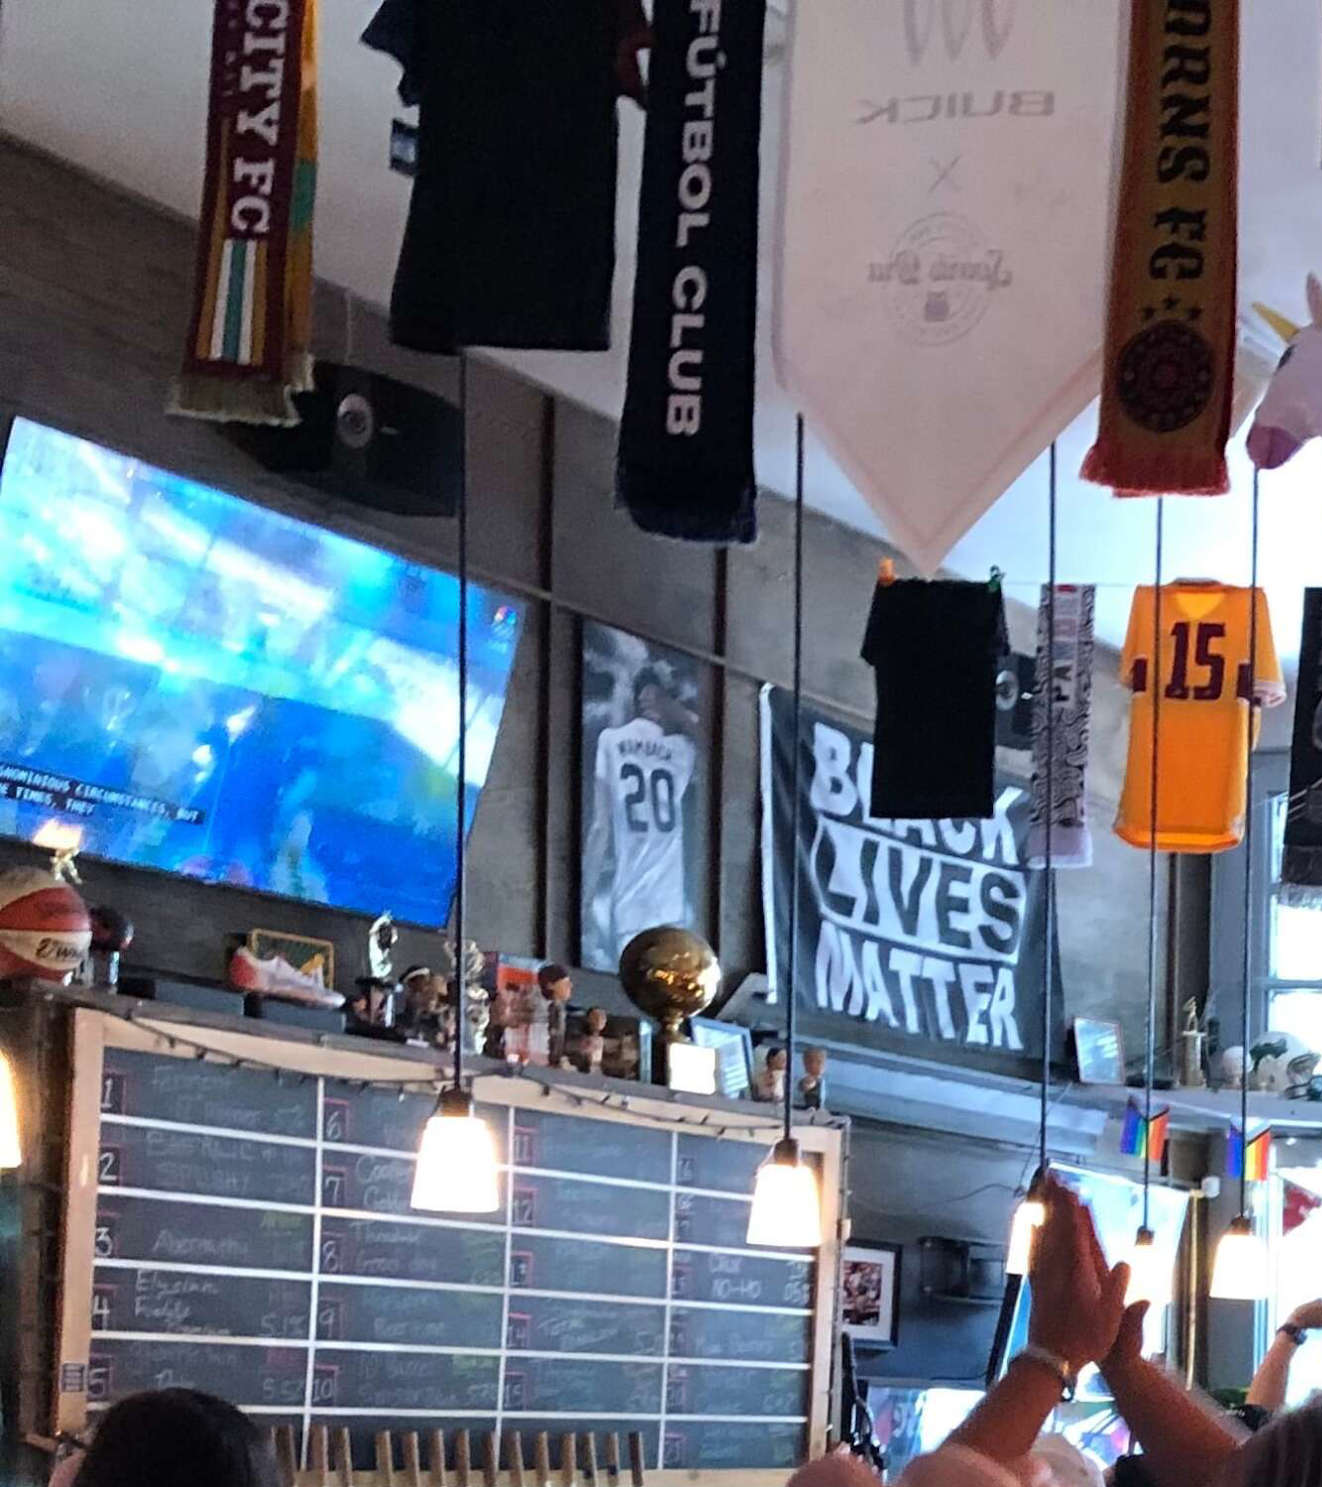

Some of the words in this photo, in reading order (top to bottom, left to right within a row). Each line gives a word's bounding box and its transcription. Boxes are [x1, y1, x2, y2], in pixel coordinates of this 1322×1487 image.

[236, 0, 289, 146] CITY
[231, 157, 275, 234] FC
[1149, 206, 1207, 281] FC
[666, 265, 707, 435] CLUB
[1163, 621, 1227, 702] 15
[620, 762, 676, 833] 20
[814, 824, 1022, 956] LIVES
[815, 920, 1024, 1050] MATTER
[325, 1110, 342, 1140] 6
[99, 1152, 118, 1181] 2
[324, 1176, 341, 1205] 7
[95, 1227, 113, 1256] 3
[322, 1240, 339, 1271] 8
[91, 1295, 110, 1331] 4
[319, 1307, 335, 1339] 9
[311, 1377, 333, 1402] 10
